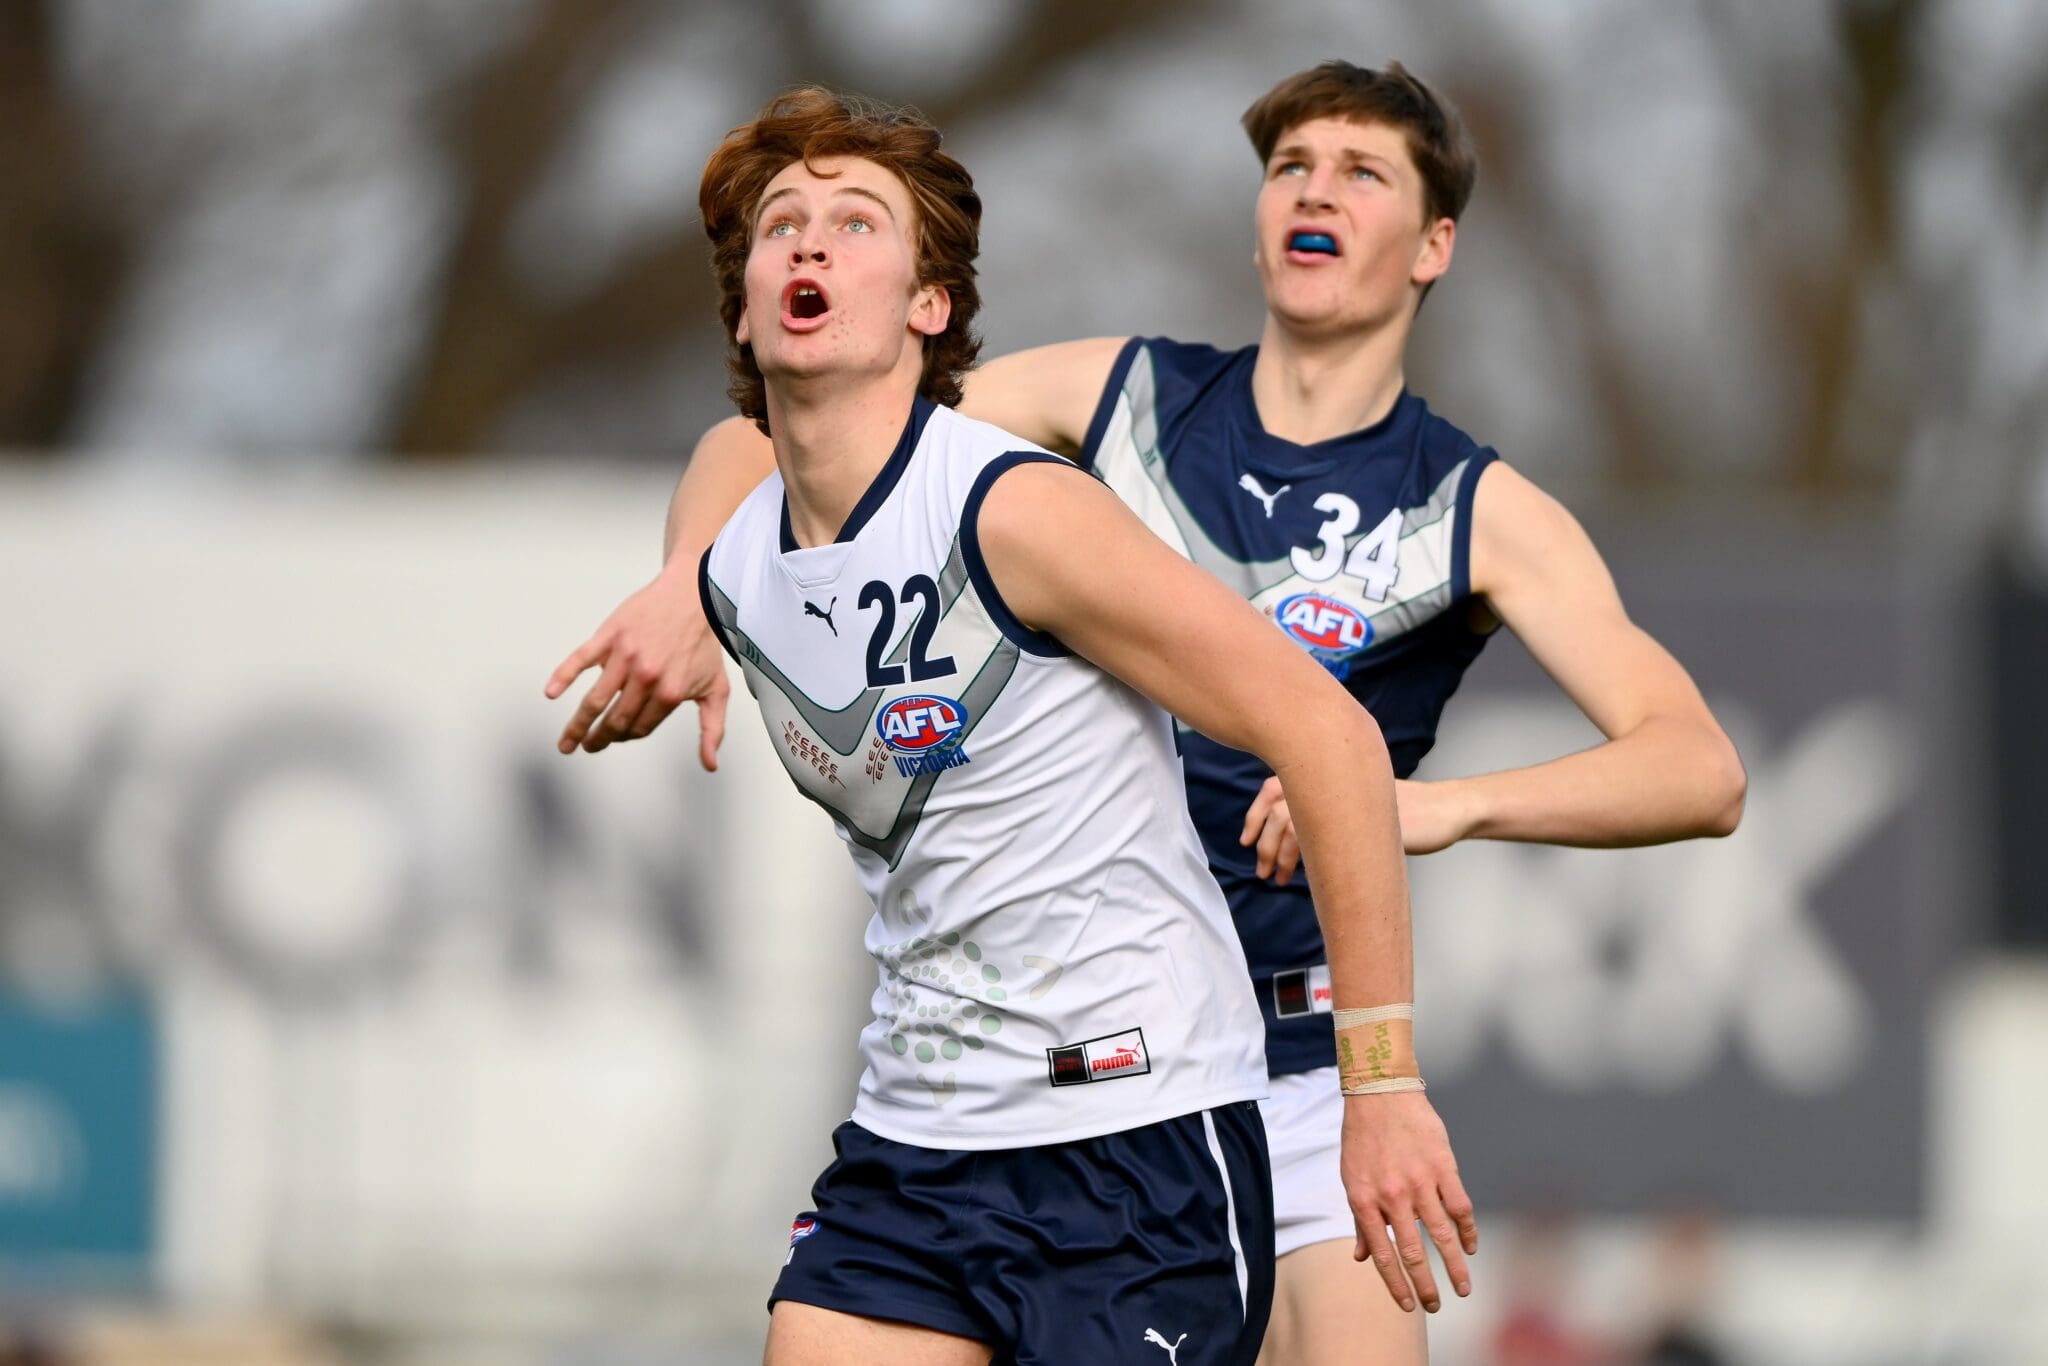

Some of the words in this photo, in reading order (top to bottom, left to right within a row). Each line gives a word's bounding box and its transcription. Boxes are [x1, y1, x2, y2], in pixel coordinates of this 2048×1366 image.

[1290, 492, 1404, 603] 34
[857, 573, 958, 688] 22
[1281, 601, 1364, 648] AFL
[884, 704, 962, 740] AFL
[892, 745, 971, 779] VICTORIA
[1092, 1053, 1135, 1072] PUMA
